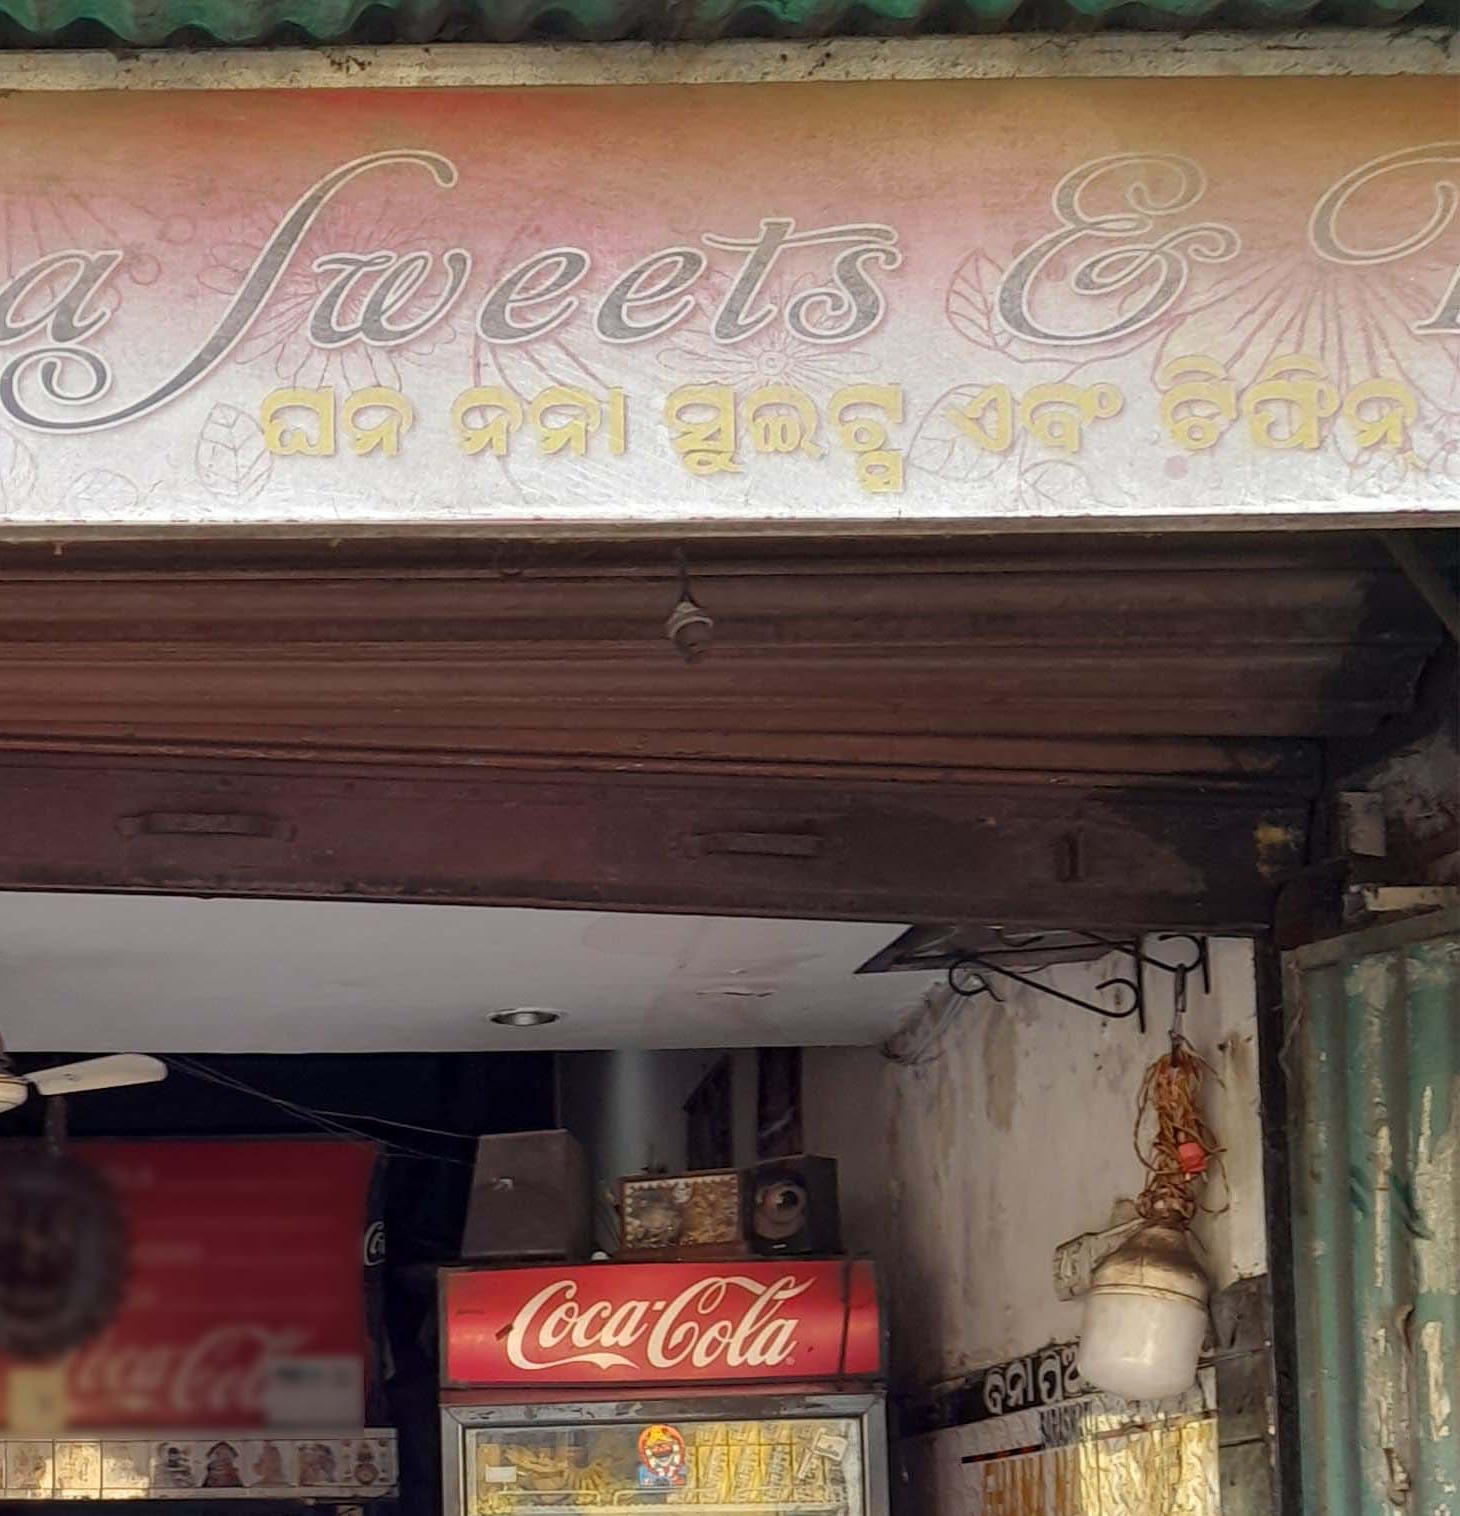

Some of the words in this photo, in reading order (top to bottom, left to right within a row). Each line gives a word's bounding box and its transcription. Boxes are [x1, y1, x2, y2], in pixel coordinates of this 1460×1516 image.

[260, 385, 414, 458] ଘନ
[450, 385, 628, 457] ନନା
[505, 1276, 816, 1371] Coca-Cola
